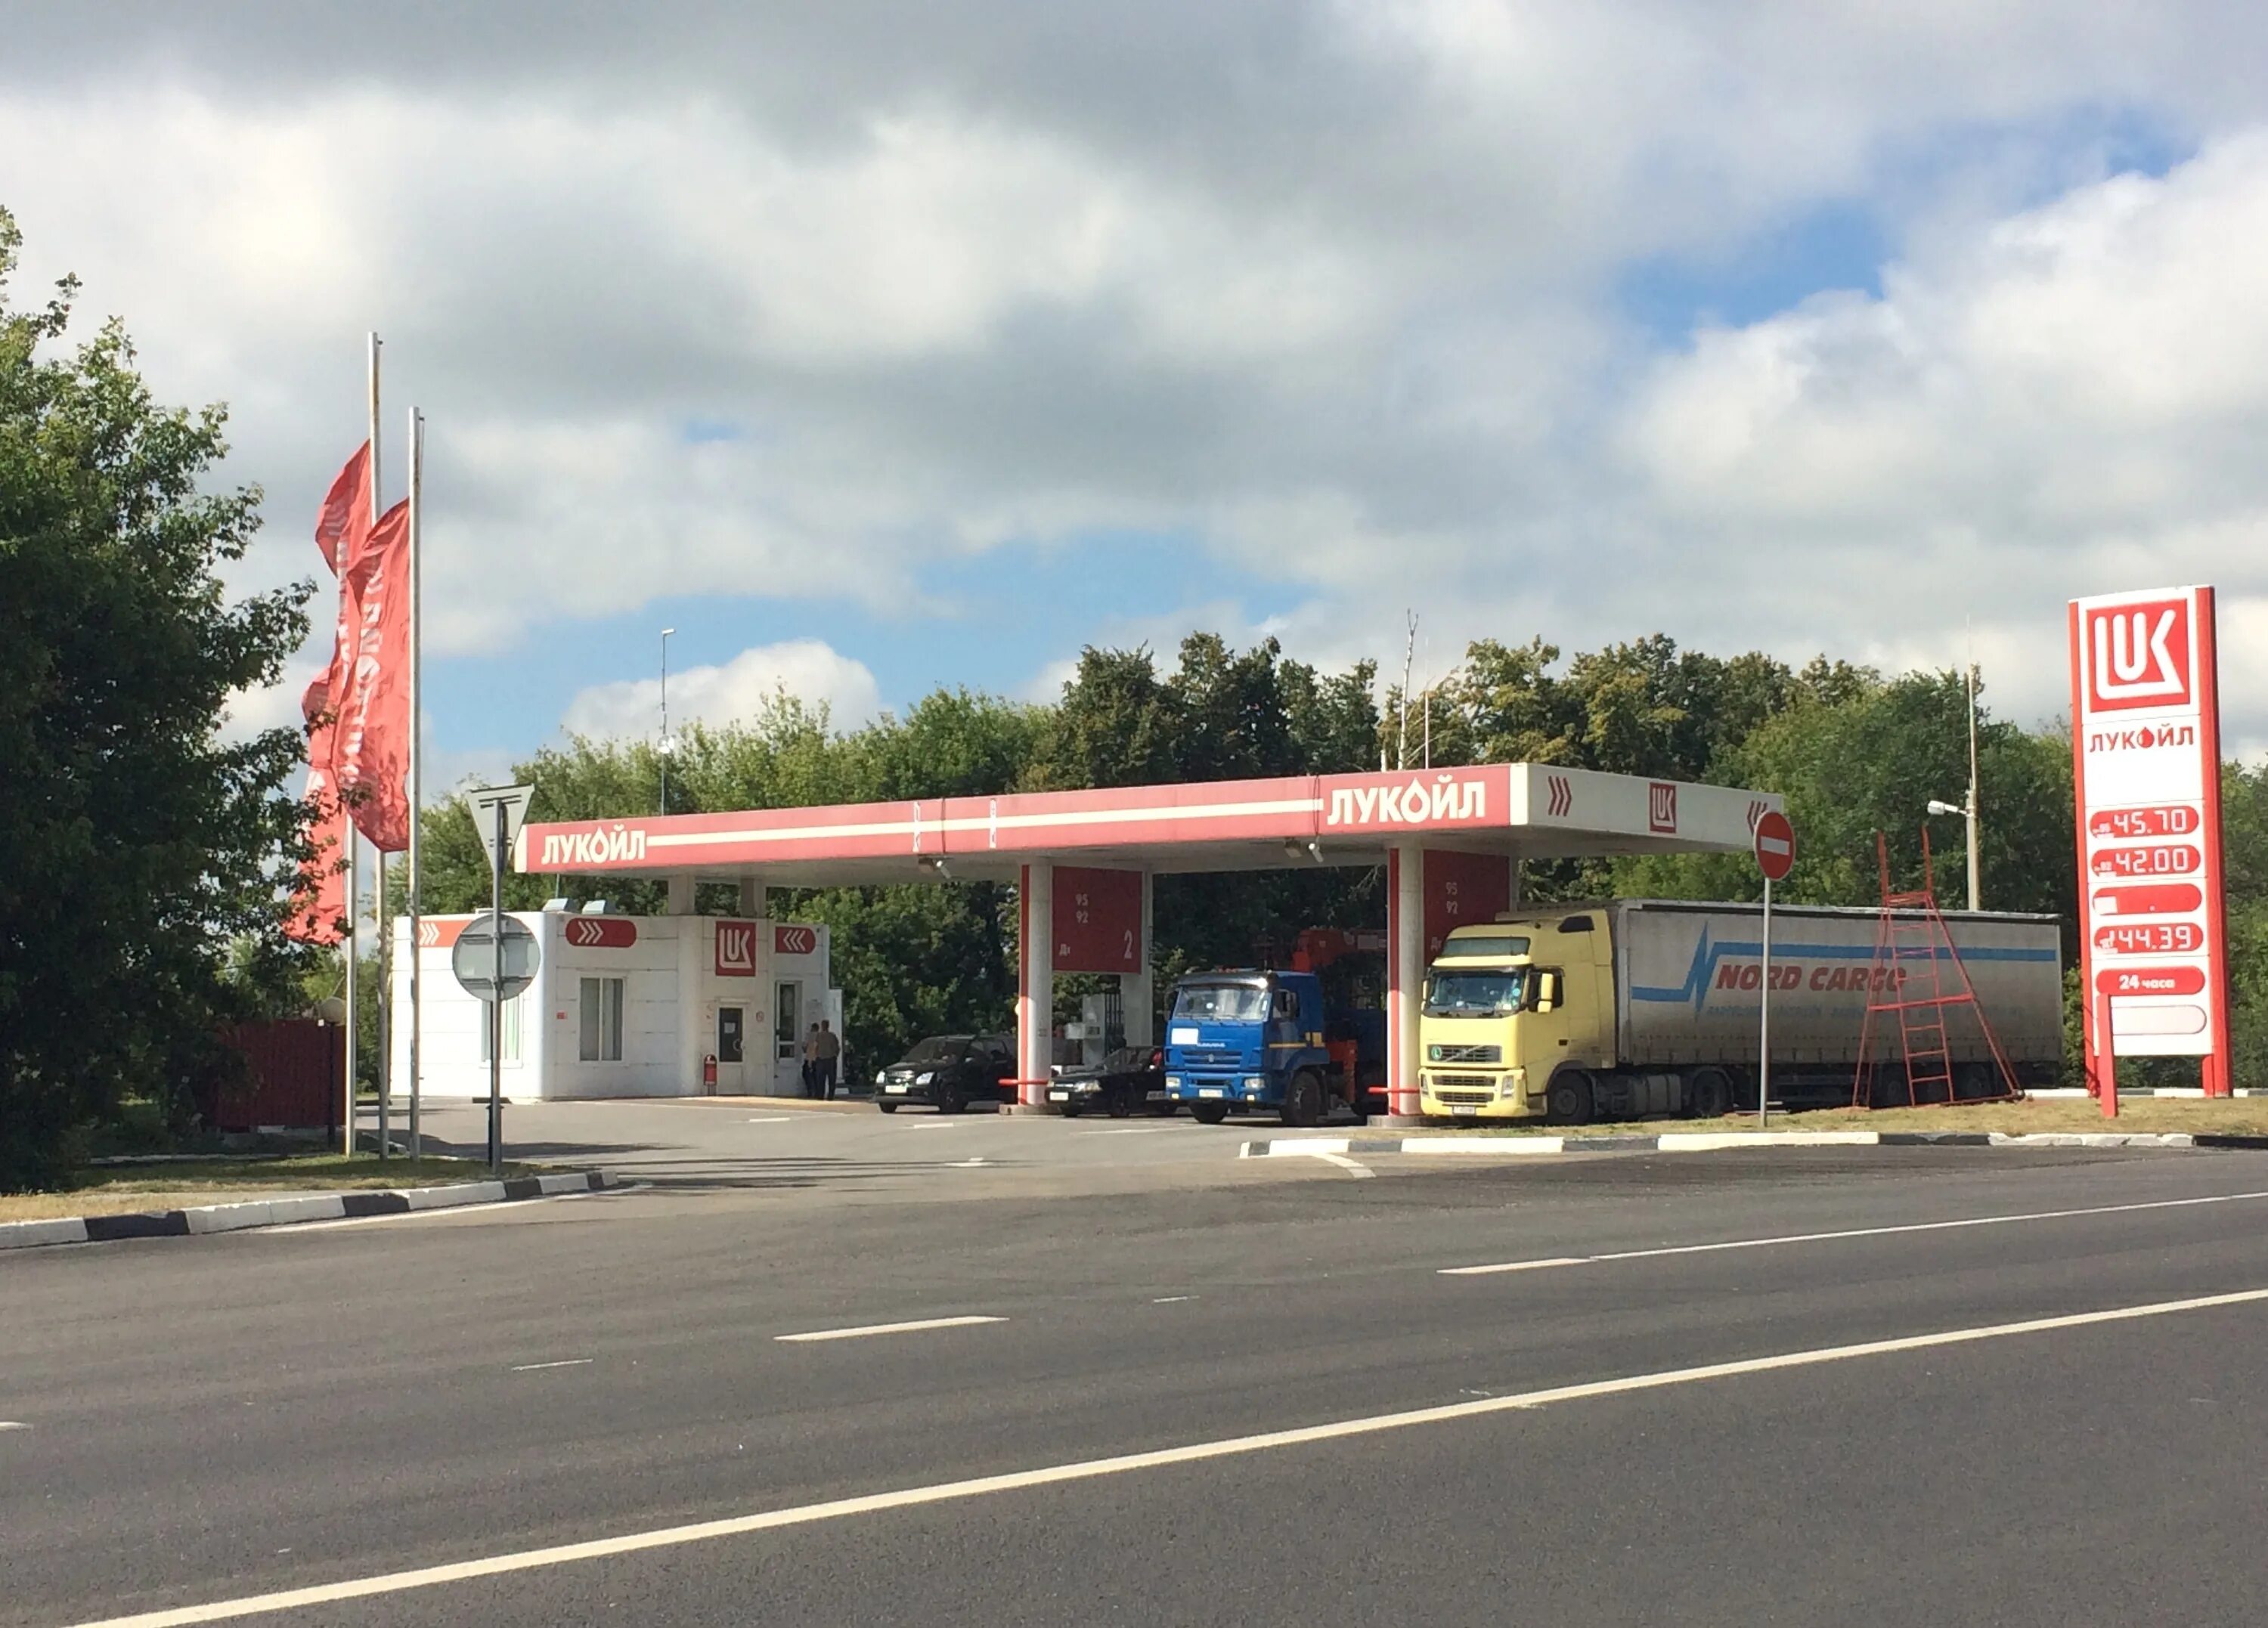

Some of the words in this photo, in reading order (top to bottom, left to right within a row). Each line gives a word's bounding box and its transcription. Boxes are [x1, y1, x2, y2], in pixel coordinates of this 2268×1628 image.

[2090, 723, 2194, 753] ЛУКОЙЛ
[1327, 774, 1486, 826] ЛУКОЙЛ
[541, 824, 646, 865] ЛУКОЙЛ
[2115, 848, 2189, 873] 42.00
[1075, 893, 1089, 906] 95
[1445, 881, 1458, 896] 95
[1076, 910, 1089, 924] 92
[1123, 930, 1132, 959] 2
[1715, 964, 1802, 991] NORD
[1808, 966, 1907, 992] CARGO
[2119, 974, 2140, 990] 24
